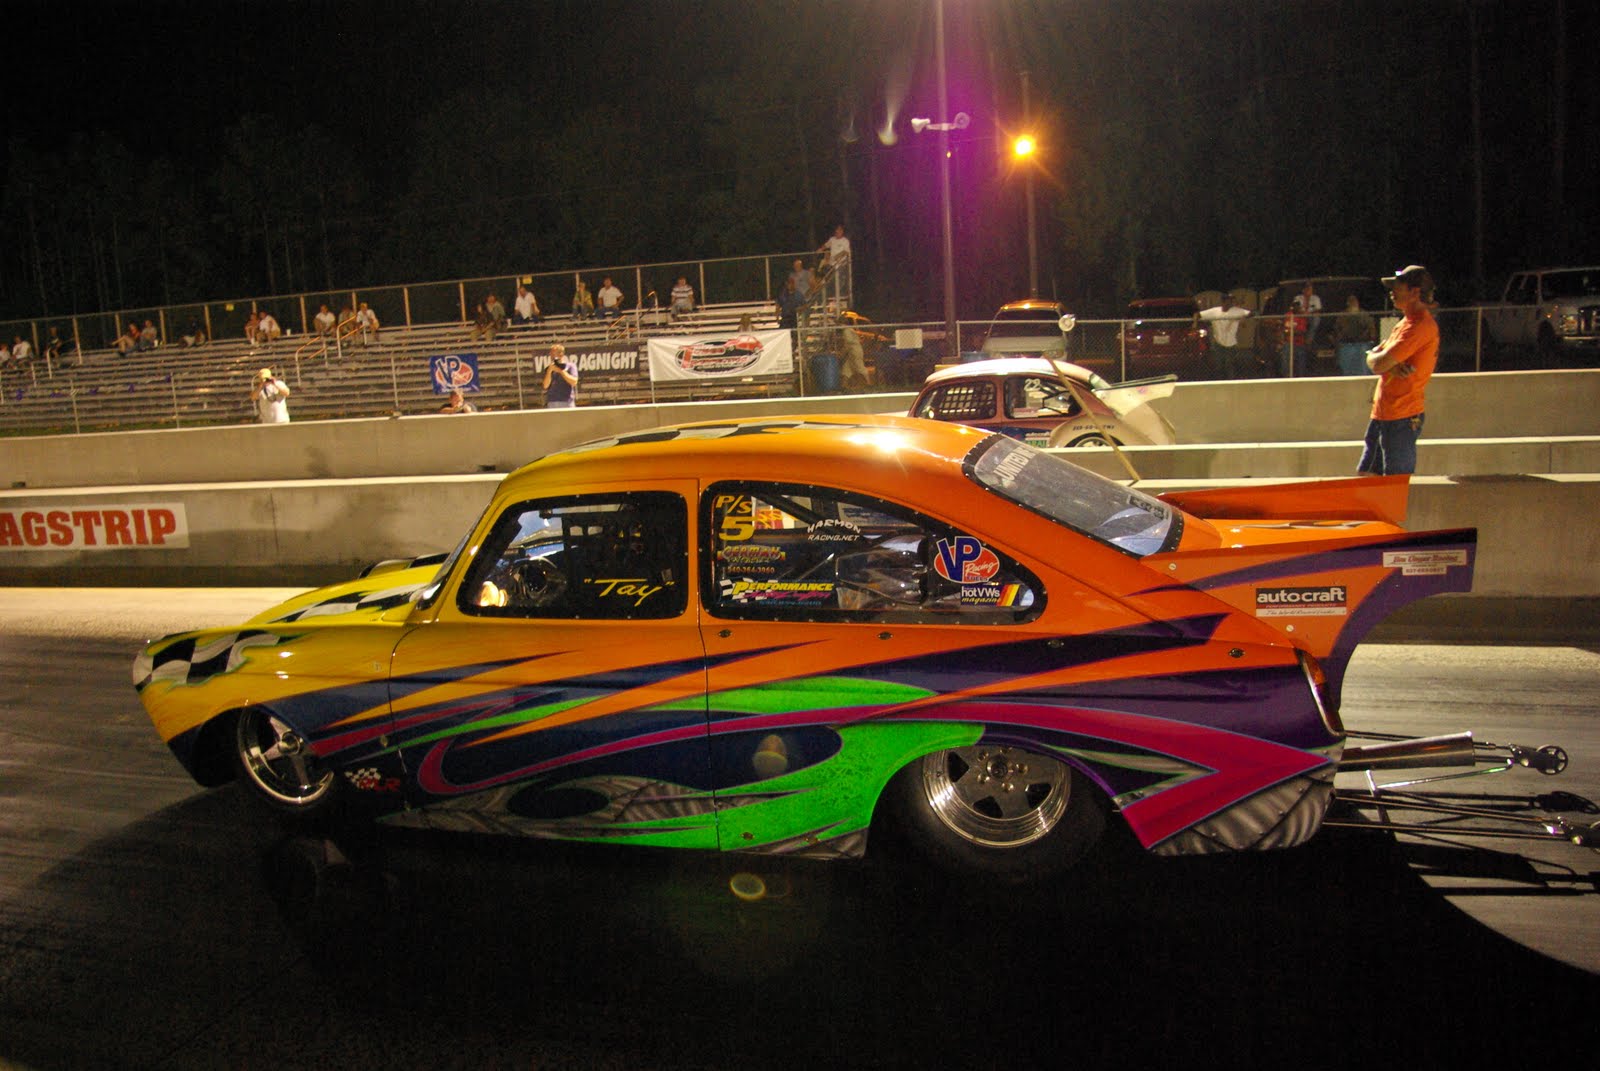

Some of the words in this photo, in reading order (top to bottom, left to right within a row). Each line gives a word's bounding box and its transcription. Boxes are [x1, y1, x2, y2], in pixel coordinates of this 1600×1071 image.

[435, 356, 460, 387] VP
[1024, 378, 1041, 391] 22
[715, 495, 753, 514] P/S
[0, 509, 176, 546] AGSTRIP
[718, 516, 758, 541] 5
[807, 519, 861, 534] HARMON
[936, 536, 982, 582] VP
[964, 562, 998, 577] Racing
[732, 582, 835, 595] PERFORMANCE
[1257, 587, 1345, 603] autocraft
